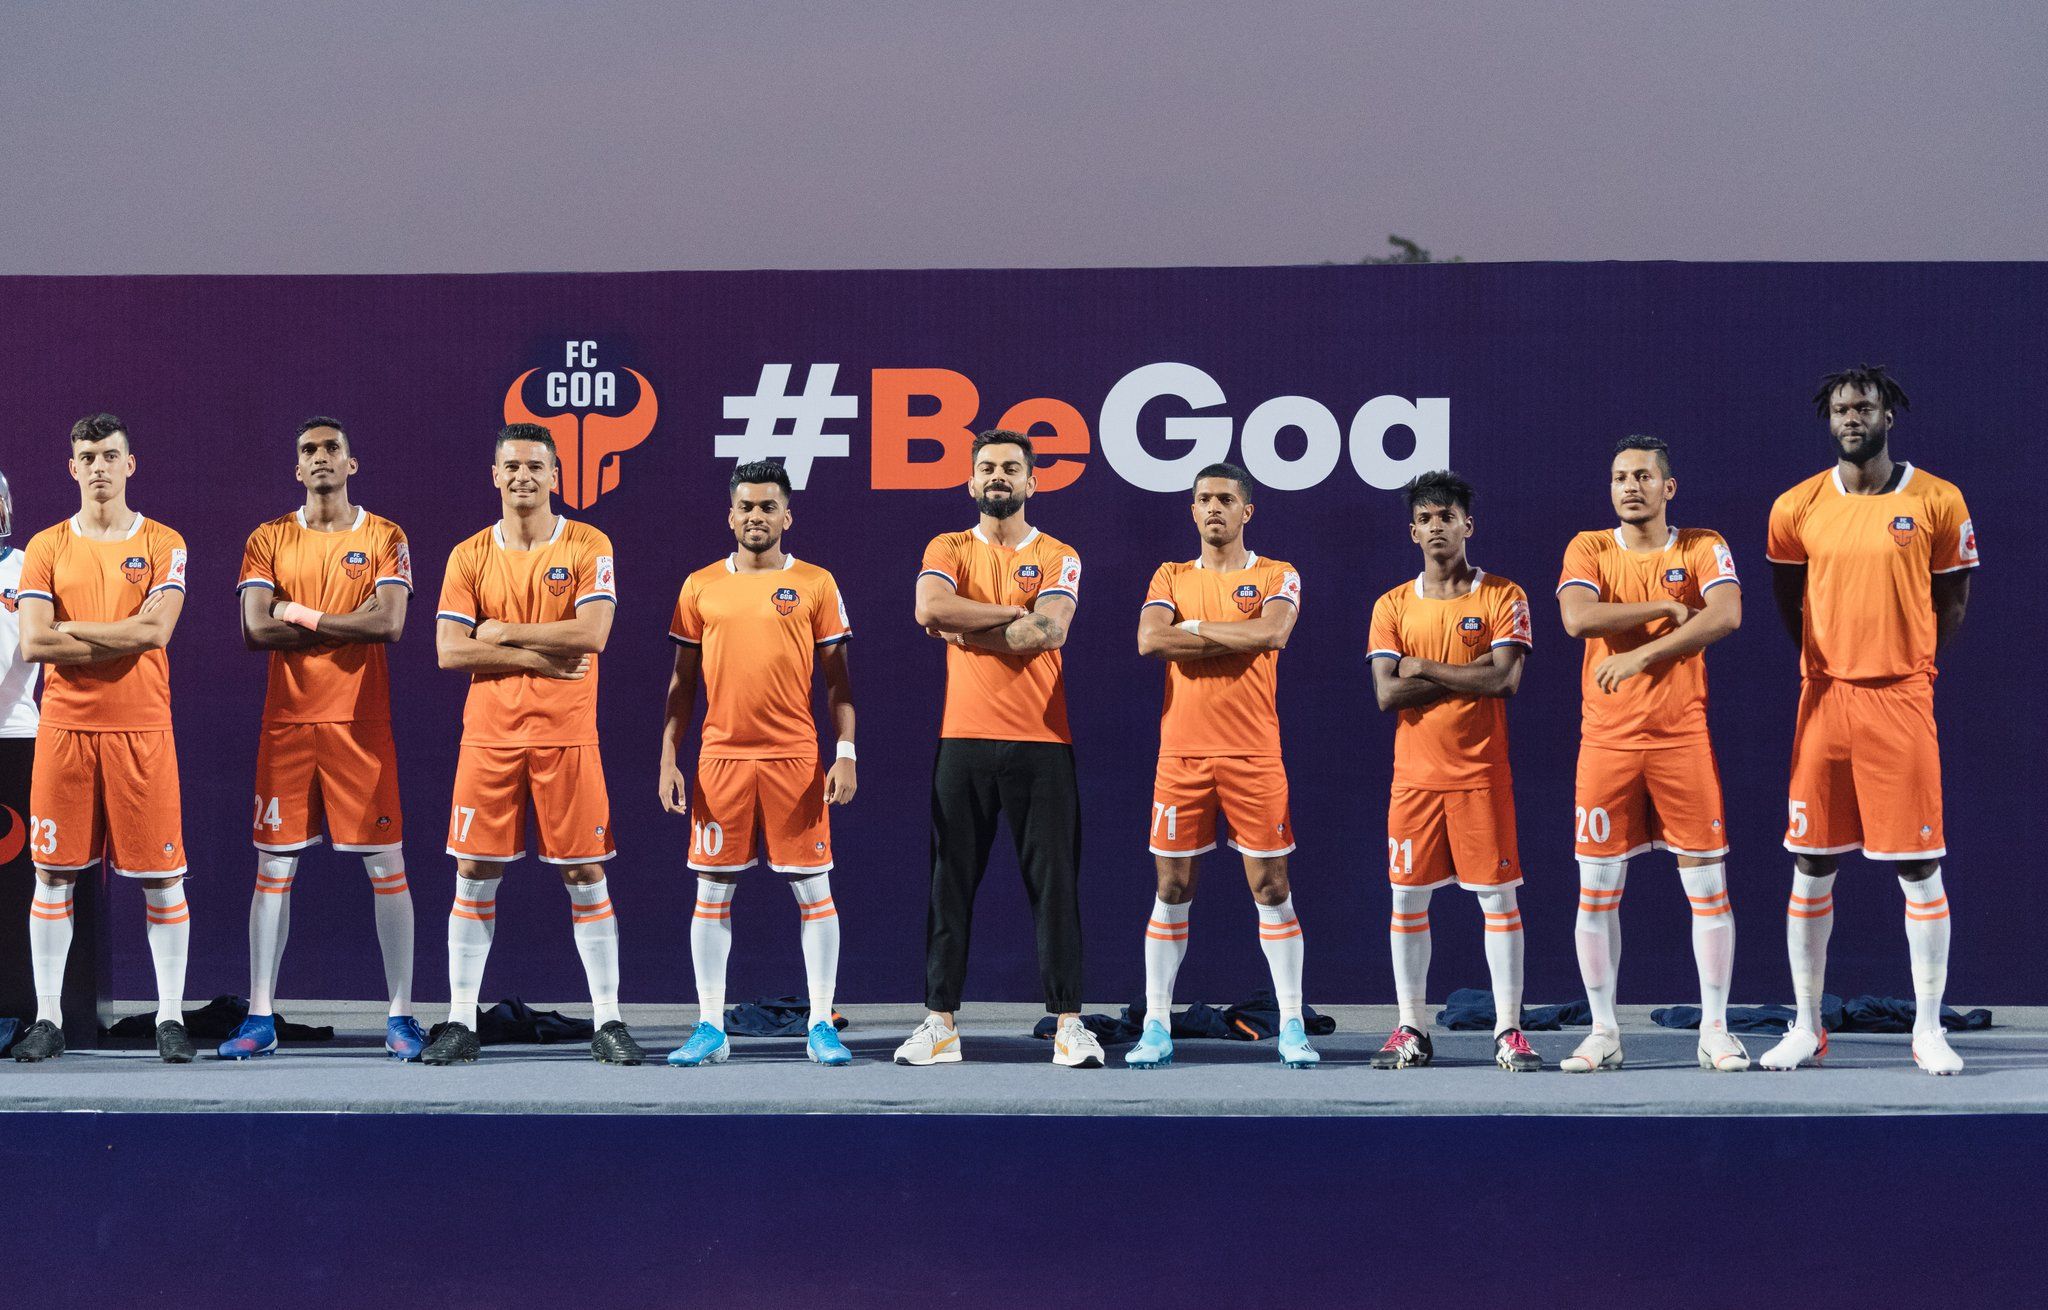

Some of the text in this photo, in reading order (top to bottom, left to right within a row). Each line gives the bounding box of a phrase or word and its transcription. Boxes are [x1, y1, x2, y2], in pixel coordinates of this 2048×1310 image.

[566, 340, 598, 368] FC
[546, 371, 616, 407] GOA
[714, 361, 1451, 494] #BeGoa
[254, 794, 283, 832] 24
[453, 804, 476, 843] 17
[1153, 801, 1177, 841] 71
[1576, 805, 1611, 844] 20
[1789, 799, 1808, 839] 5
[31, 815, 58, 855] 23
[694, 820, 724, 857] 10
[1388, 836, 1413, 876] 21
